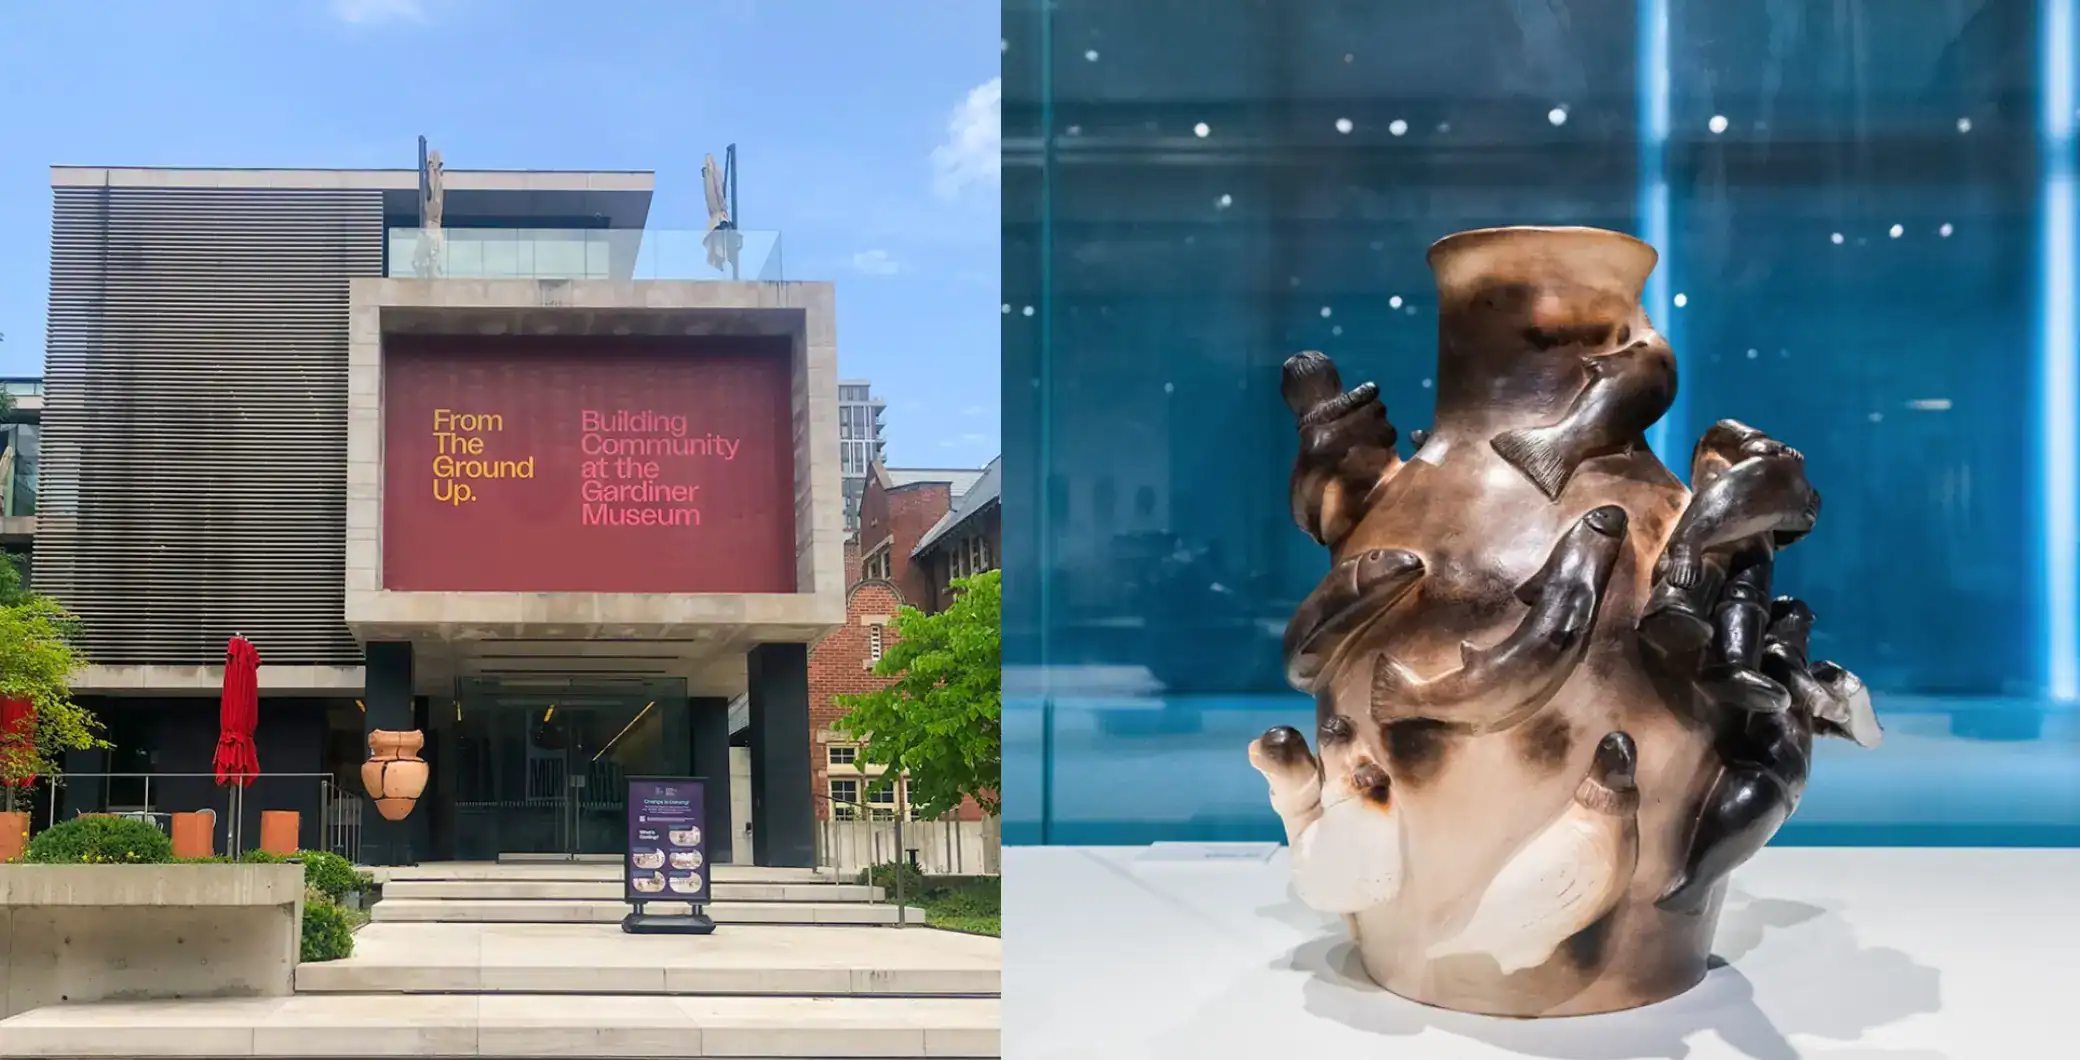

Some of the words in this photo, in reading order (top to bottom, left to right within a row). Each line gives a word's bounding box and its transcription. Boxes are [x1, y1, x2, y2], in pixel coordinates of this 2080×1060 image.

[433, 408, 503, 431] From
[581, 409, 688, 438] Building
[432, 432, 485, 455] The
[581, 432, 740, 461] Community
[432, 455, 534, 478] Ground
[581, 457, 609, 478] at
[614, 456, 660, 479] the
[433, 478, 477, 506] Up.
[581, 480, 700, 502] Gardiner
[582, 503, 700, 526] Museum
